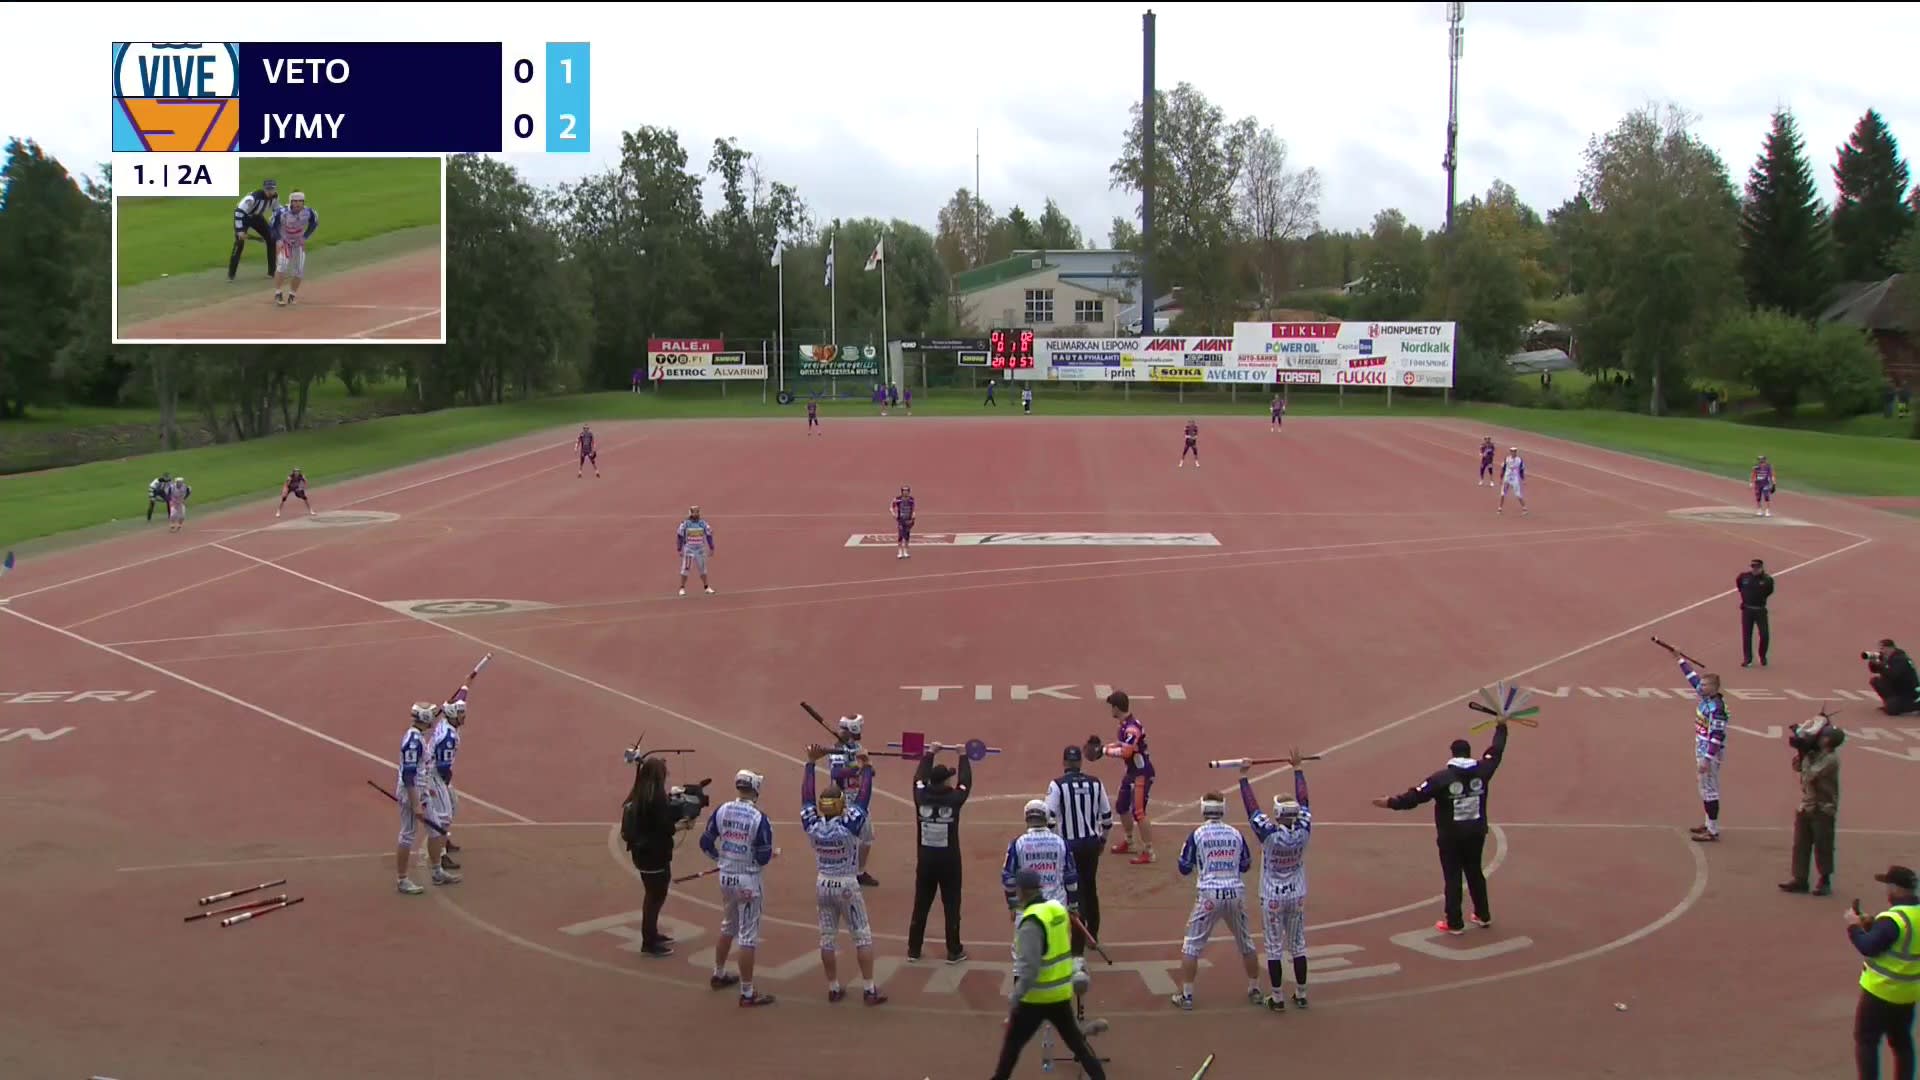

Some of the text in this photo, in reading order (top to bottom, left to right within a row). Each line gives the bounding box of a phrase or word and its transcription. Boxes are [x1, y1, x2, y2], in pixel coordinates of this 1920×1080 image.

[1381, 326, 1442, 335] HONPUMET OY
[661, 341, 710, 351] RALE.fi
[1047, 341, 1139, 350] NELIMARKAN LEIPOMO
[1144, 339, 1186, 351] AVANT
[1192, 339, 1234, 351] AVANT
[1266, 342, 1319, 352] POWER OIL
[1401, 341, 1451, 352] Nordkalk
[666, 368, 707, 376] BETROC
[714, 367, 763, 376] ALVARIINI
[1252, 370, 1268, 380] OY
[900, 684, 1188, 701] TIKLI
